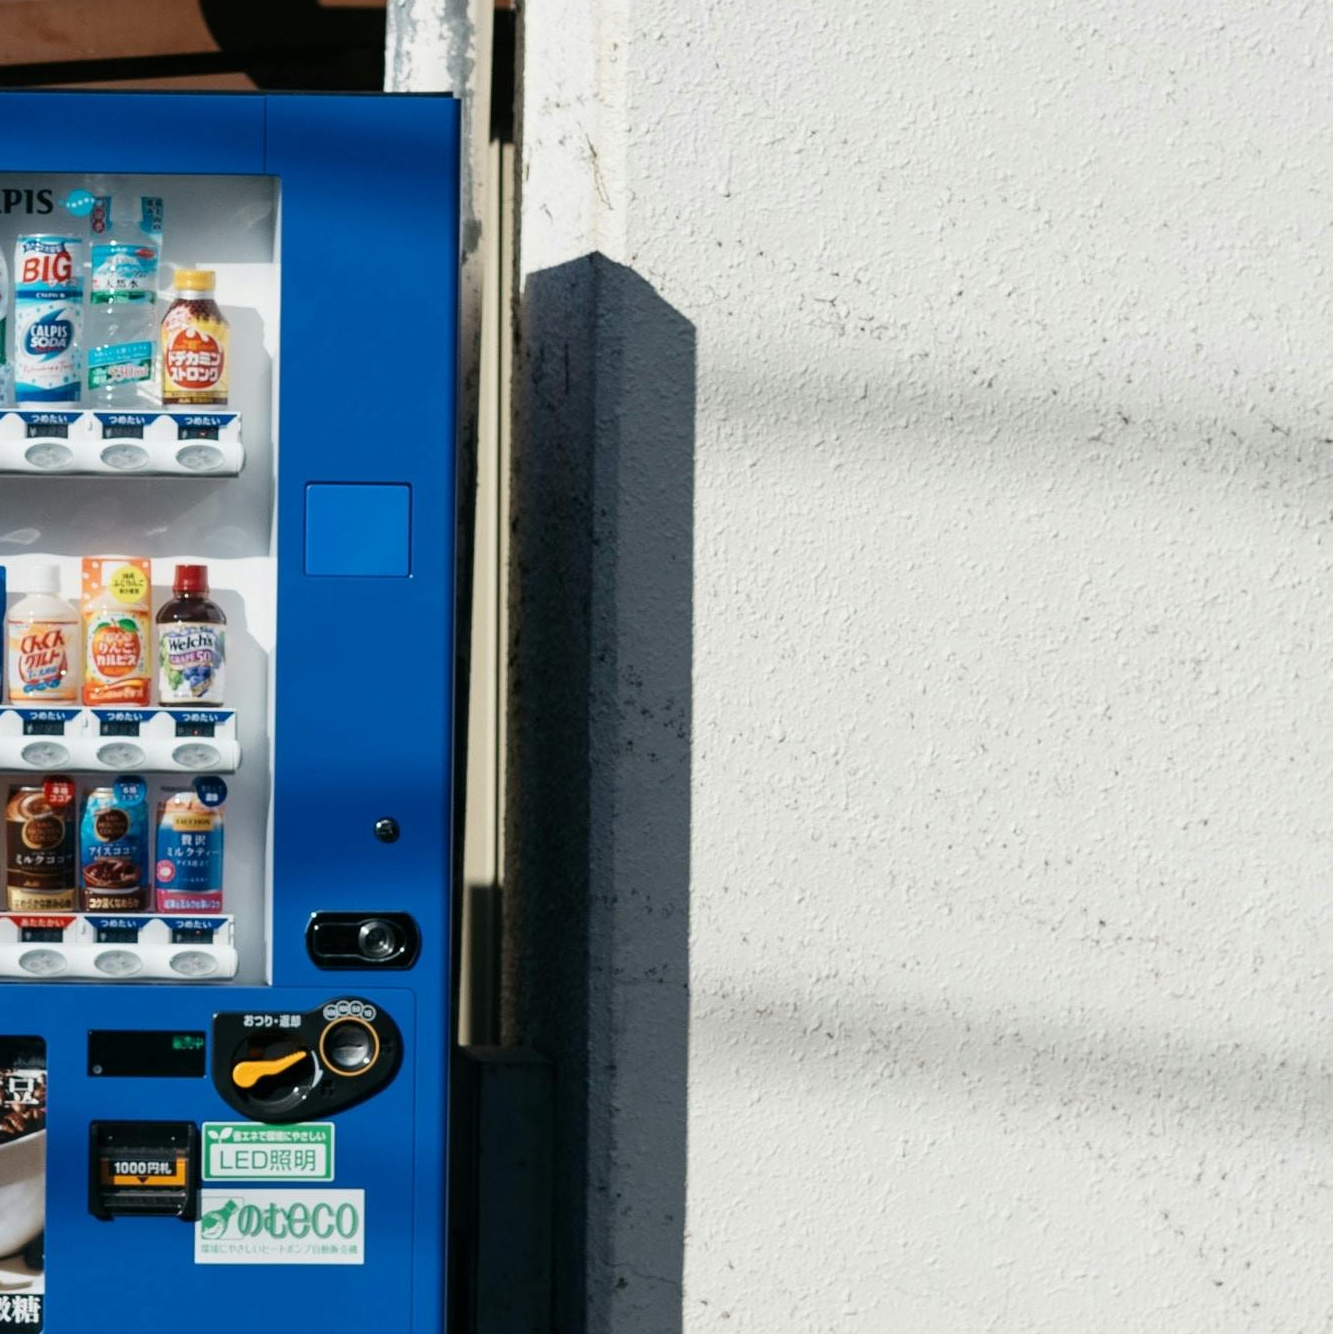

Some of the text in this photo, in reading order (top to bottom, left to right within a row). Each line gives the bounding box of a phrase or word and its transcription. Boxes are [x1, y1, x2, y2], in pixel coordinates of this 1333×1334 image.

[23, 251, 72, 283] BIG
[31, 325, 67, 338] CALPIS
[30, 337, 66, 348] SODA
[168, 351, 221, 365] ドデカミン
[170, 367, 218, 381] ストロング
[31, 414, 67, 423] つめたい
[109, 415, 145, 424] つめたい
[185, 416, 221, 425] つめたい
[97, 654, 137, 666] カルピス
[195, 650, 212, 662] 50
[30, 711, 66, 720] つめたい
[107, 711, 143, 721] つめたい
[182, 712, 218, 722] つめたい
[167, 846, 219, 857] ミルクティー
[20, 917, 65, 927] あたたかい
[100, 918, 137, 928] つめたい
[175, 919, 212, 929] つめたい
[220, 1149, 316, 1171] LED照明
[114, 1161, 173, 1175] 1000円札
[238, 1202, 359, 1239] のむeco
